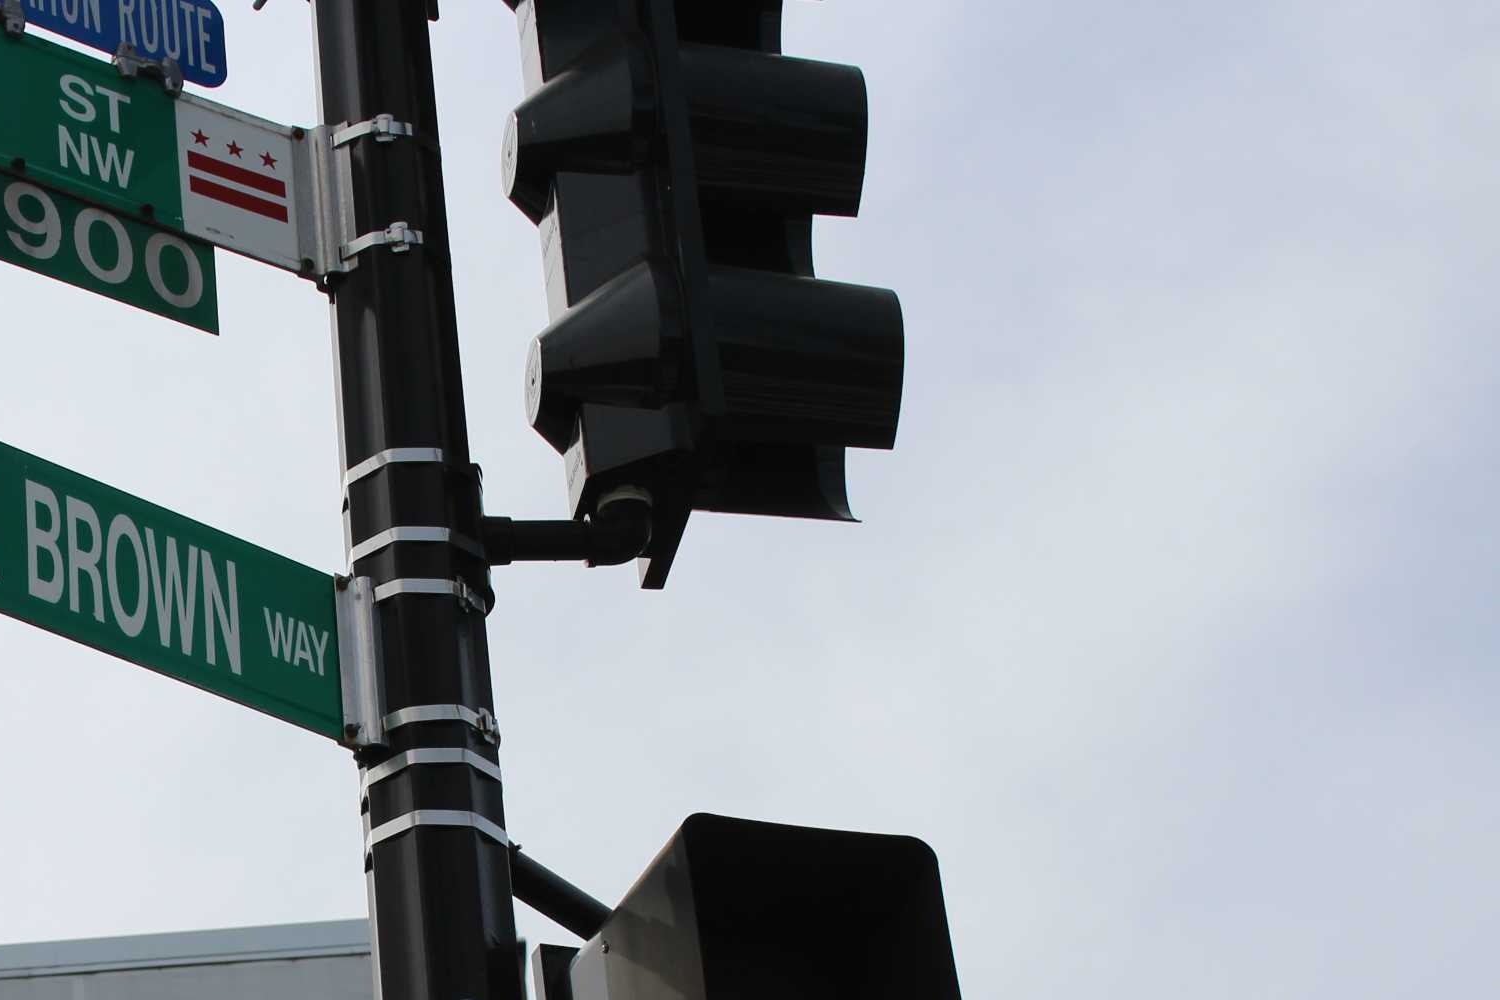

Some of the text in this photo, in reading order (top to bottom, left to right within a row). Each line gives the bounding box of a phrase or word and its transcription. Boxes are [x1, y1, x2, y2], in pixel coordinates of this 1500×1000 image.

[118, 0, 216, 75] ROUTE
[58, 73, 131, 133] ST
[58, 124, 134, 189] NW
[25, 478, 242, 676] BROWN
[263, 606, 329, 676] WAY
